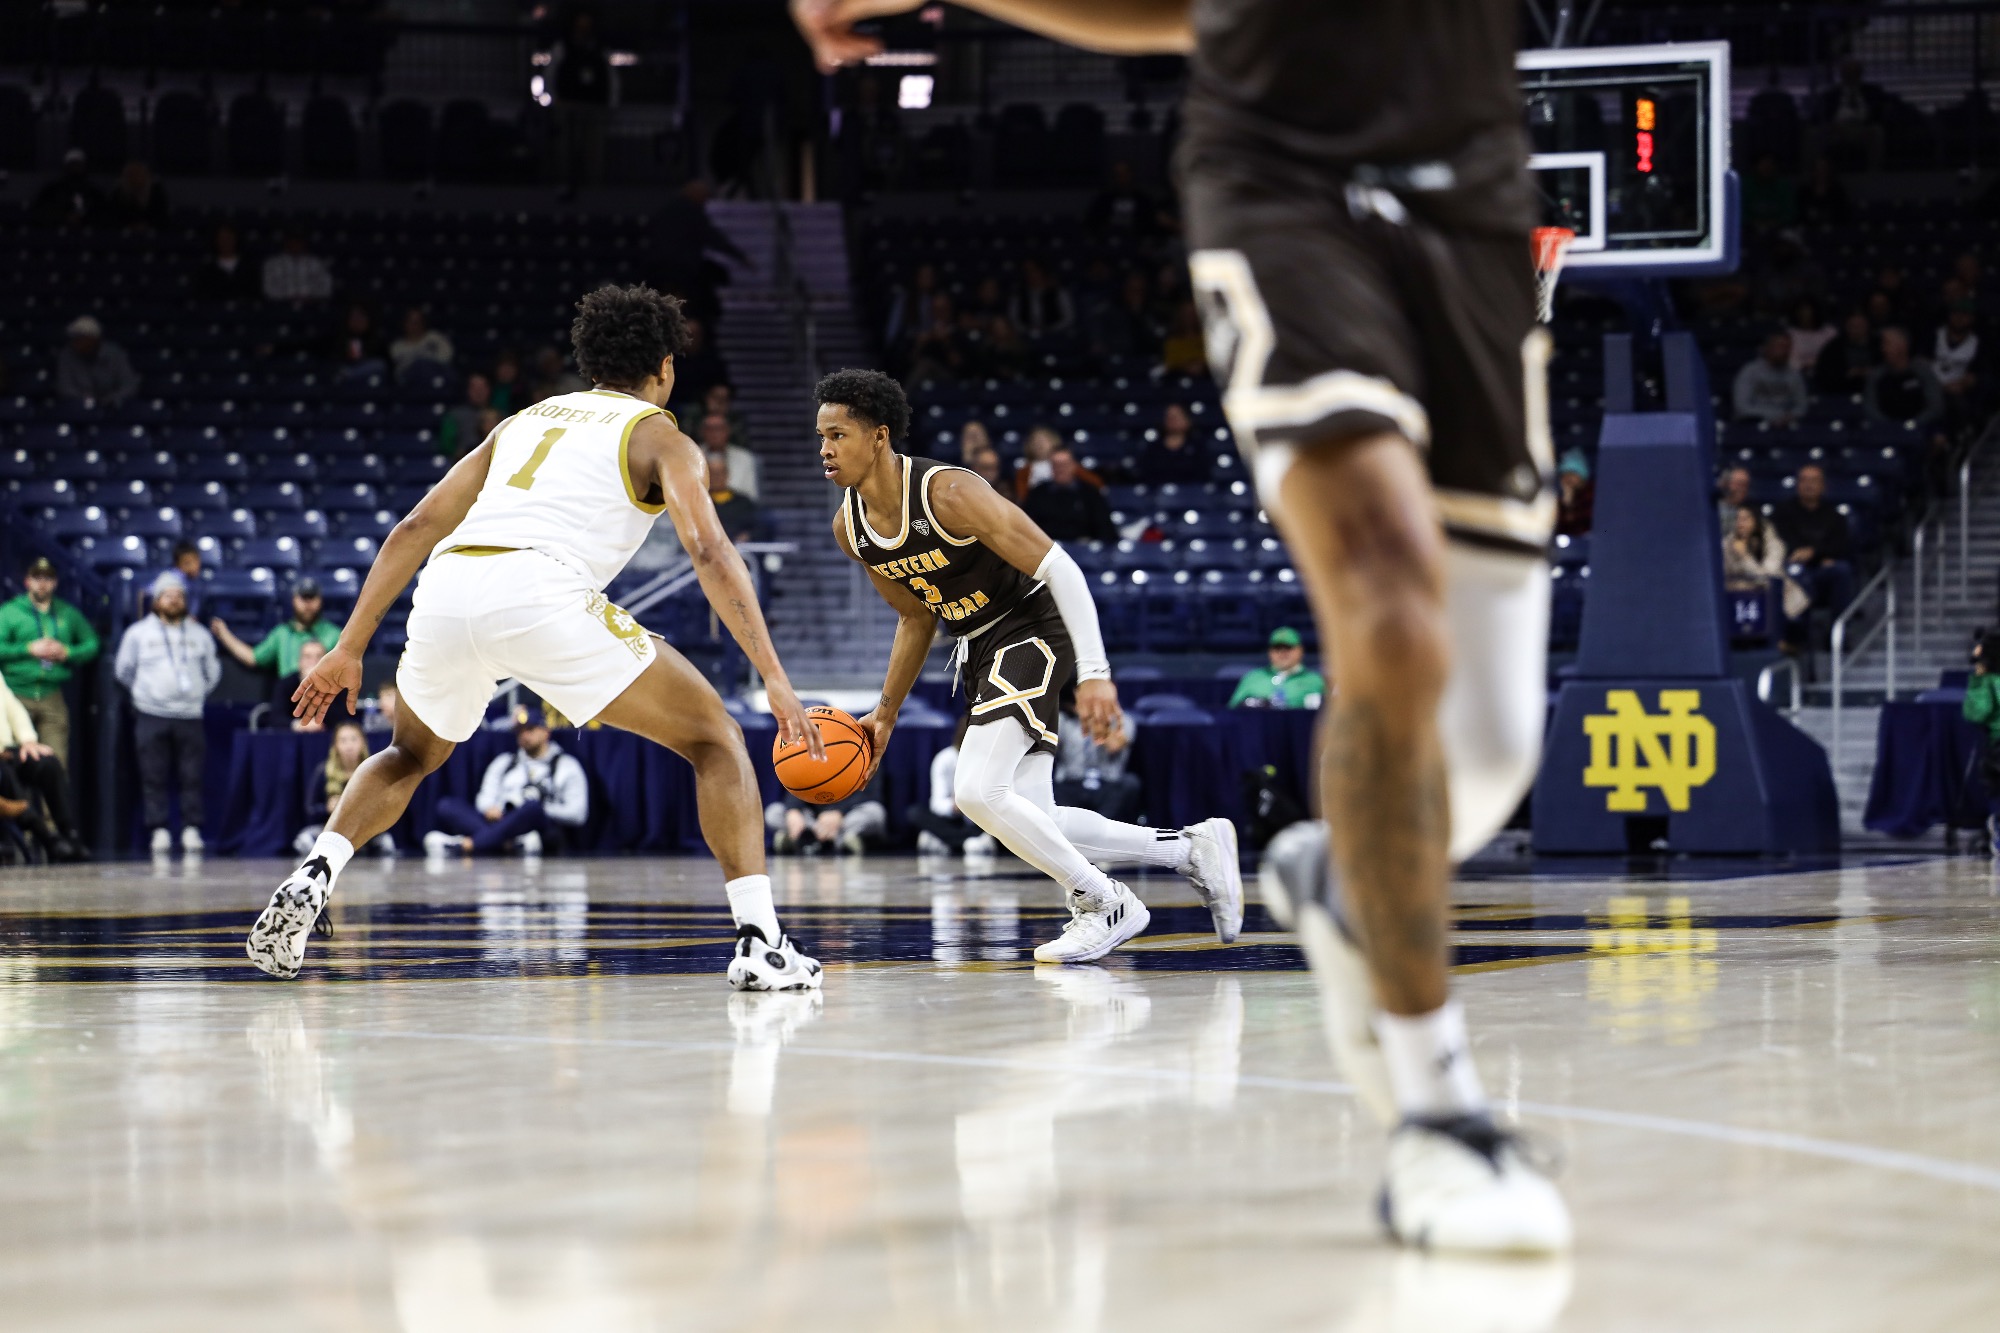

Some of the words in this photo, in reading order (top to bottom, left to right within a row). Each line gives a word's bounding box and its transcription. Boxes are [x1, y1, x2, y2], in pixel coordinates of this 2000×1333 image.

[526, 403, 595, 423] ROPER
[598, 412, 621, 424] II
[506, 427, 567, 491] 1
[909, 576, 943, 604] 3
[921, 590, 990, 621] IGAN
[1582, 689, 1717, 812] ND
